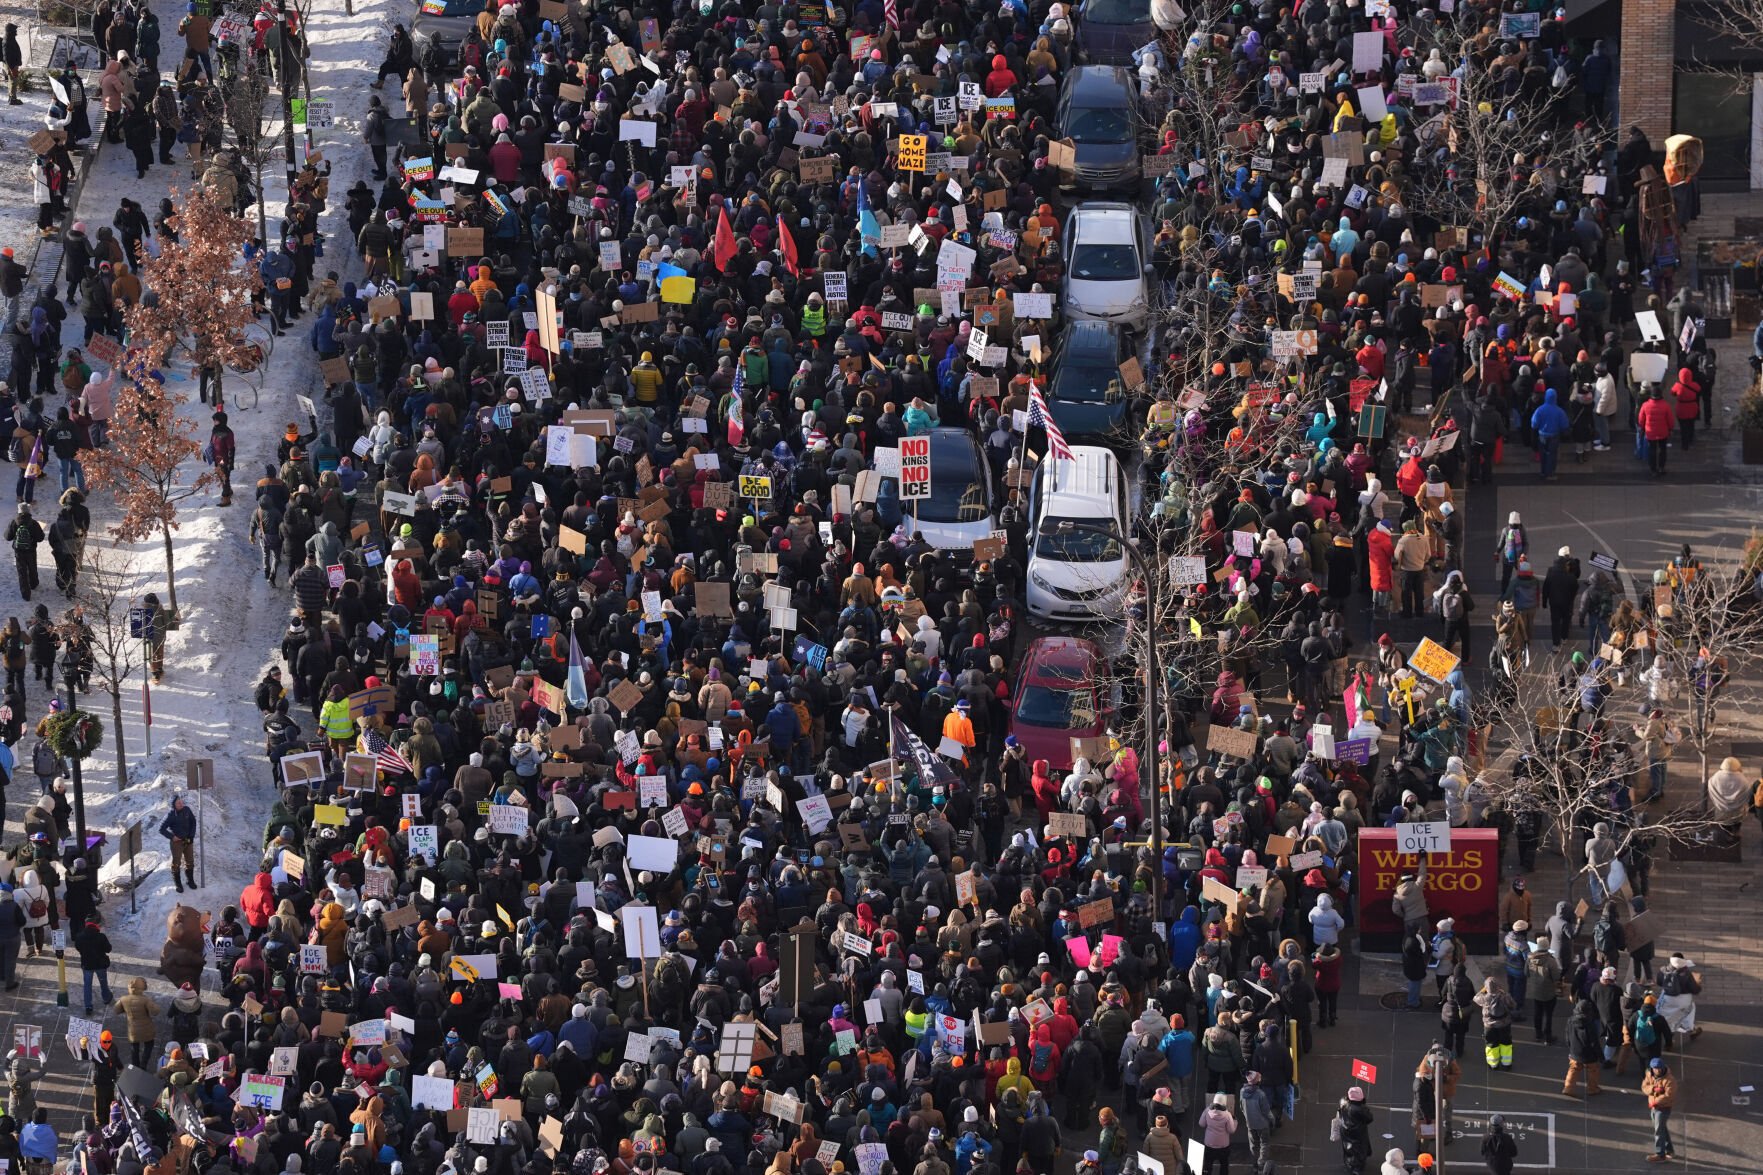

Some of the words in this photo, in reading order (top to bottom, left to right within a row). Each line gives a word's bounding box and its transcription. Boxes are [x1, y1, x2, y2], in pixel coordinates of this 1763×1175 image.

[220, 20, 244, 32] OUT
[1302, 75, 1311, 83] ICE
[963, 83, 976, 95] ICE
[938, 98, 951, 110] ICE
[903, 136, 921, 146] GO
[899, 147, 924, 157] HOME
[899, 158, 923, 169] NAZI
[827, 291, 847, 299] JUSTICE
[885, 313, 897, 321] ICE
[890, 320, 909, 328] NOW
[975, 330, 985, 344] ICE
[488, 340, 508, 348] JUSTICE
[506, 347, 526, 355] GENERAL
[506, 353, 525, 361] STRIKE
[498, 404, 510, 416] ICE
[499, 416, 512, 428] OUT
[902, 440, 928, 457] NO
[902, 455, 928, 466] KINGS
[903, 466, 928, 483] NO
[746, 477, 760, 486] BE
[707, 483, 728, 491] ICE
[742, 485, 770, 497] GOOD
[903, 482, 928, 496] ICE
[705, 490, 728, 499] OUT
[1171, 559, 1185, 567] END
[814, 644, 828, 658] ICE
[415, 664, 434, 675] US
[489, 703, 514, 713] ICE
[489, 713, 514, 723] OUT
[411, 827, 430, 837] ICE
[1412, 825, 1431, 834] ICE
[1404, 836, 1439, 849] OUT
[1372, 850, 1483, 868] WELLS
[1375, 872, 1482, 890] FRGO
[216, 940, 232, 948] NO
[304, 948, 320, 957] ICE
[304, 956, 321, 964] OUT
[947, 1034, 963, 1046] ICE
[251, 1094, 272, 1107] ICE
[822, 1142, 837, 1152] ICE
[818, 1152, 833, 1161] OUT
